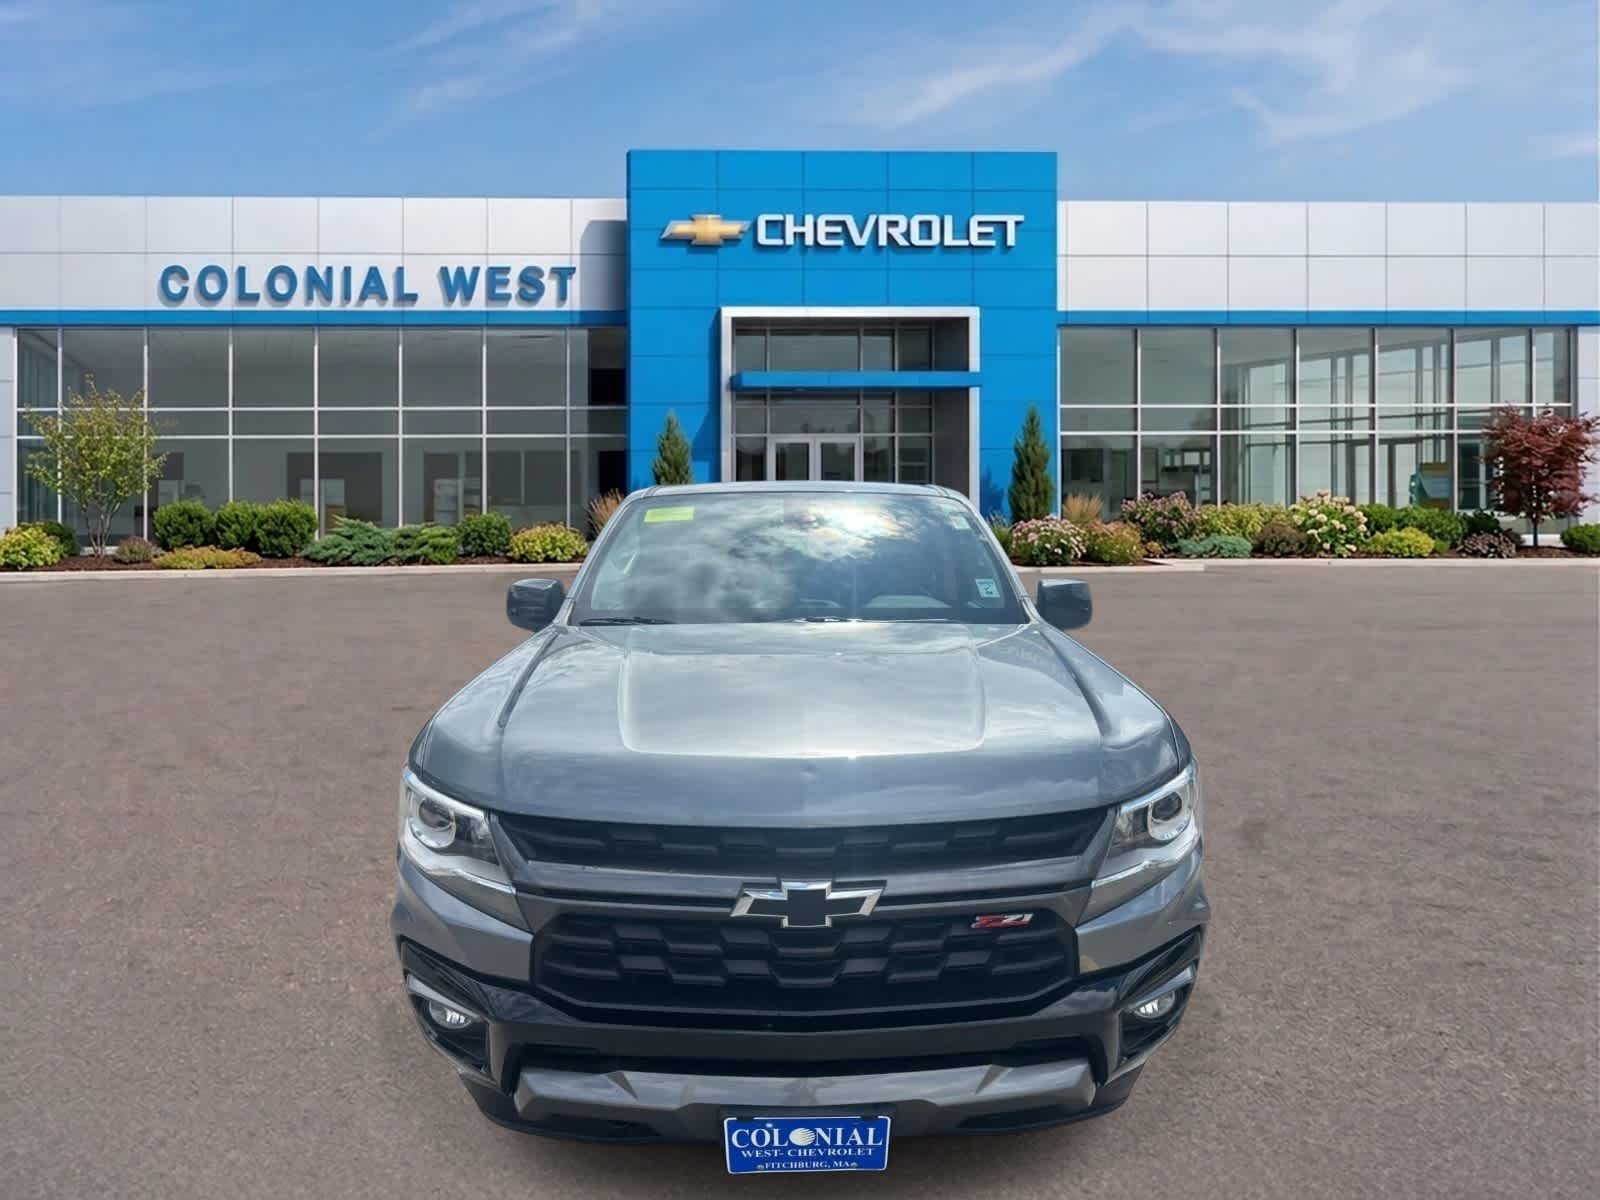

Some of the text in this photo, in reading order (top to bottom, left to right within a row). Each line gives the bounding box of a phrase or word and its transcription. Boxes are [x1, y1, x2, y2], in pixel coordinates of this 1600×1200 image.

[757, 213, 1024, 247] CHEVROLET
[159, 264, 577, 306] COLONIAL WEST
[833, 1160, 849, 1168] MA
